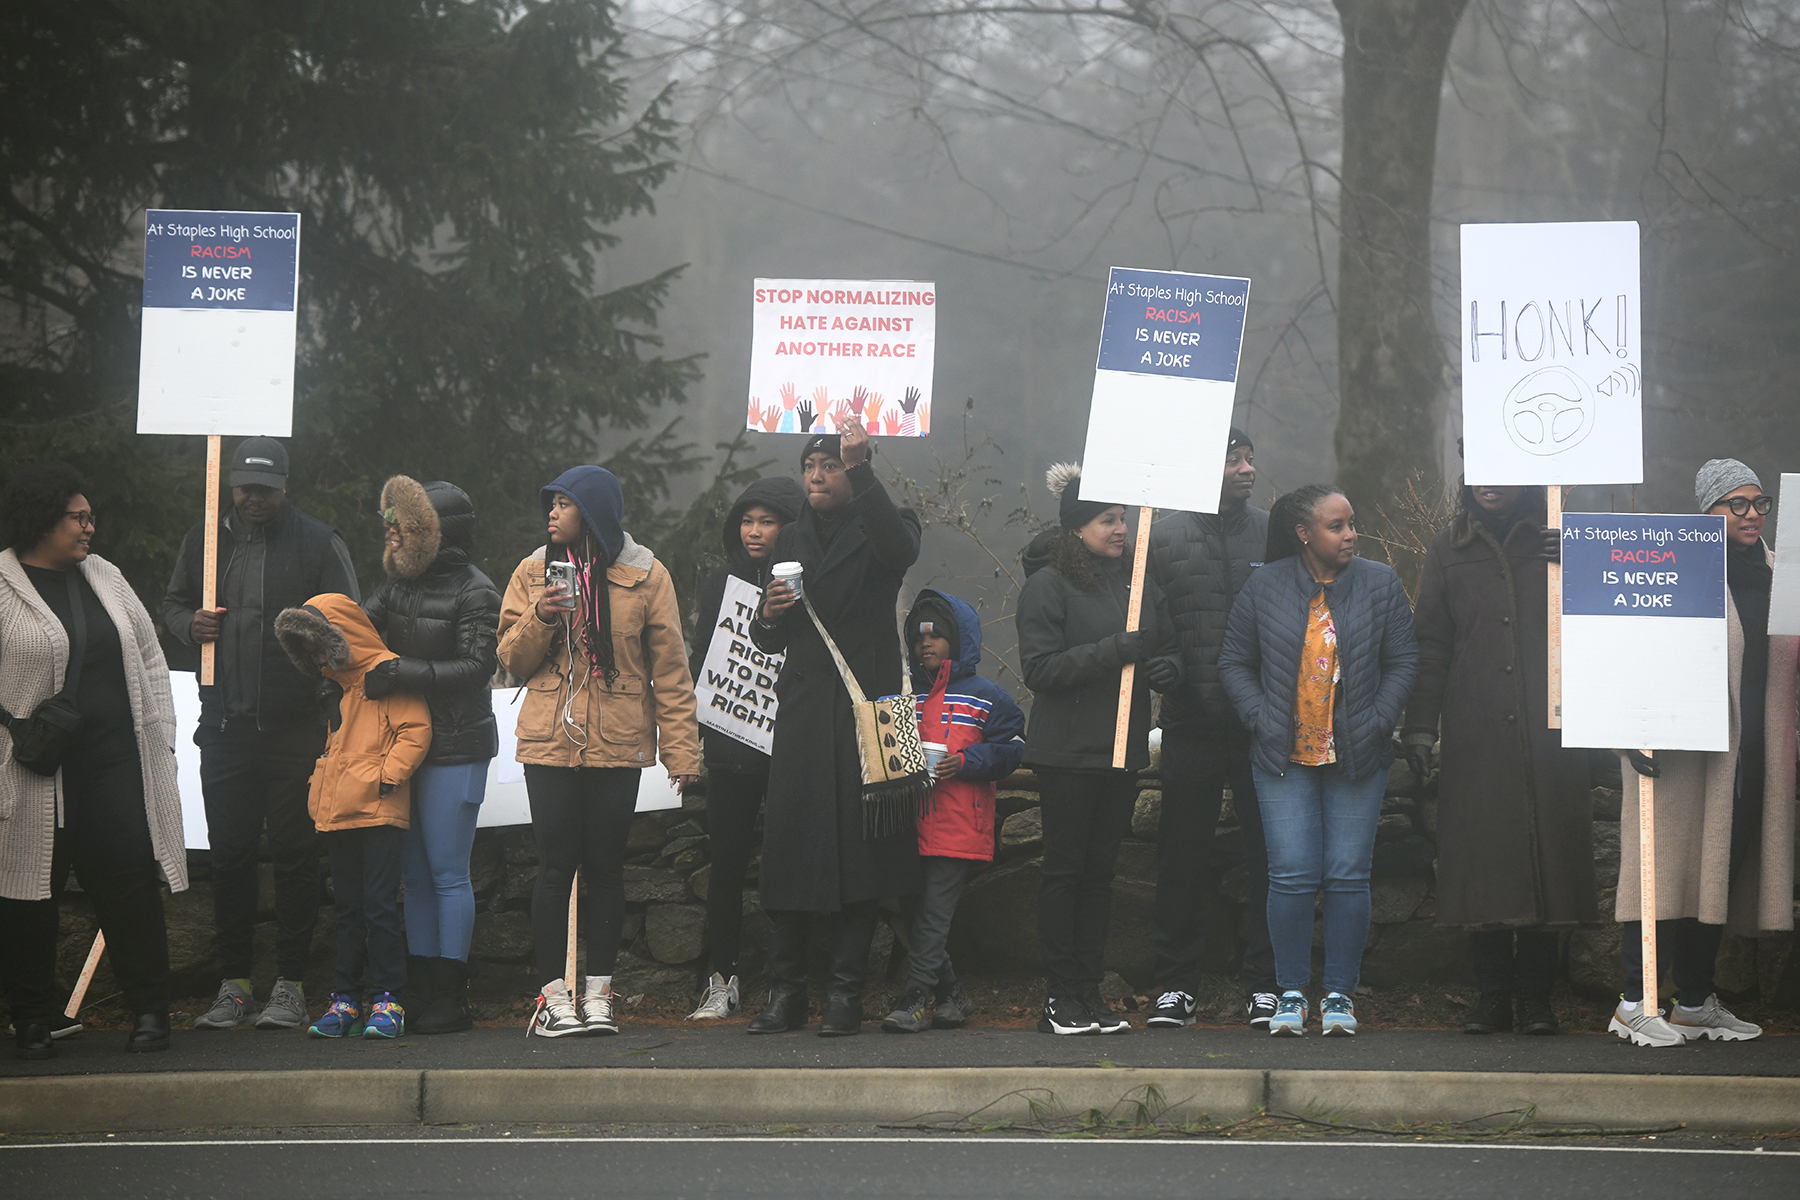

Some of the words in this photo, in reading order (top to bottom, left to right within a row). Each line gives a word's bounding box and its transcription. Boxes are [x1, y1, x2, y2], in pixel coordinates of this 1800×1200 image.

[147, 224, 163, 235] At
[167, 224, 216, 241] Staples
[221, 225, 249, 242] High
[253, 226, 295, 239] School
[191, 245, 251, 259] RACISM
[182, 265, 197, 278] IS
[202, 266, 252, 279] NEVER
[191, 286, 203, 299] A
[207, 287, 246, 301] JOKE
[756, 289, 803, 303] STOP
[807, 290, 935, 305] NORMALIZING
[1110, 282, 1124, 295] At
[1128, 283, 1171, 302] Staples
[1176, 288, 1201, 307] High
[1206, 291, 1244, 306] School
[780, 316, 827, 330] HATE
[831, 317, 913, 331] AGAINST
[1145, 307, 1200, 325] RACISM
[1135, 328, 1149, 342] IS
[1153, 330, 1200, 346] NEVER
[1471, 295, 1627, 362] HONK!
[775, 341, 863, 356] ANOTHER
[867, 344, 916, 357] RACE
[1140, 351, 1151, 364] A
[1156, 352, 1191, 368] JOKE
[1563, 528, 1580, 540] At
[1585, 527, 1637, 545] Staples
[1642, 528, 1674, 546] High
[1678, 529, 1723, 543] School
[1611, 549, 1676, 564] RACISM
[1603, 571, 1619, 584] IS
[1625, 572, 1678, 585] NEVER
[1614, 594, 1627, 607] A
[1632, 594, 1672, 608] JOKE
[736, 601, 754, 622] TI
[728, 639, 782, 676] RIGH
[726, 658, 752, 682] TO
[707, 669, 775, 712] WHAT
